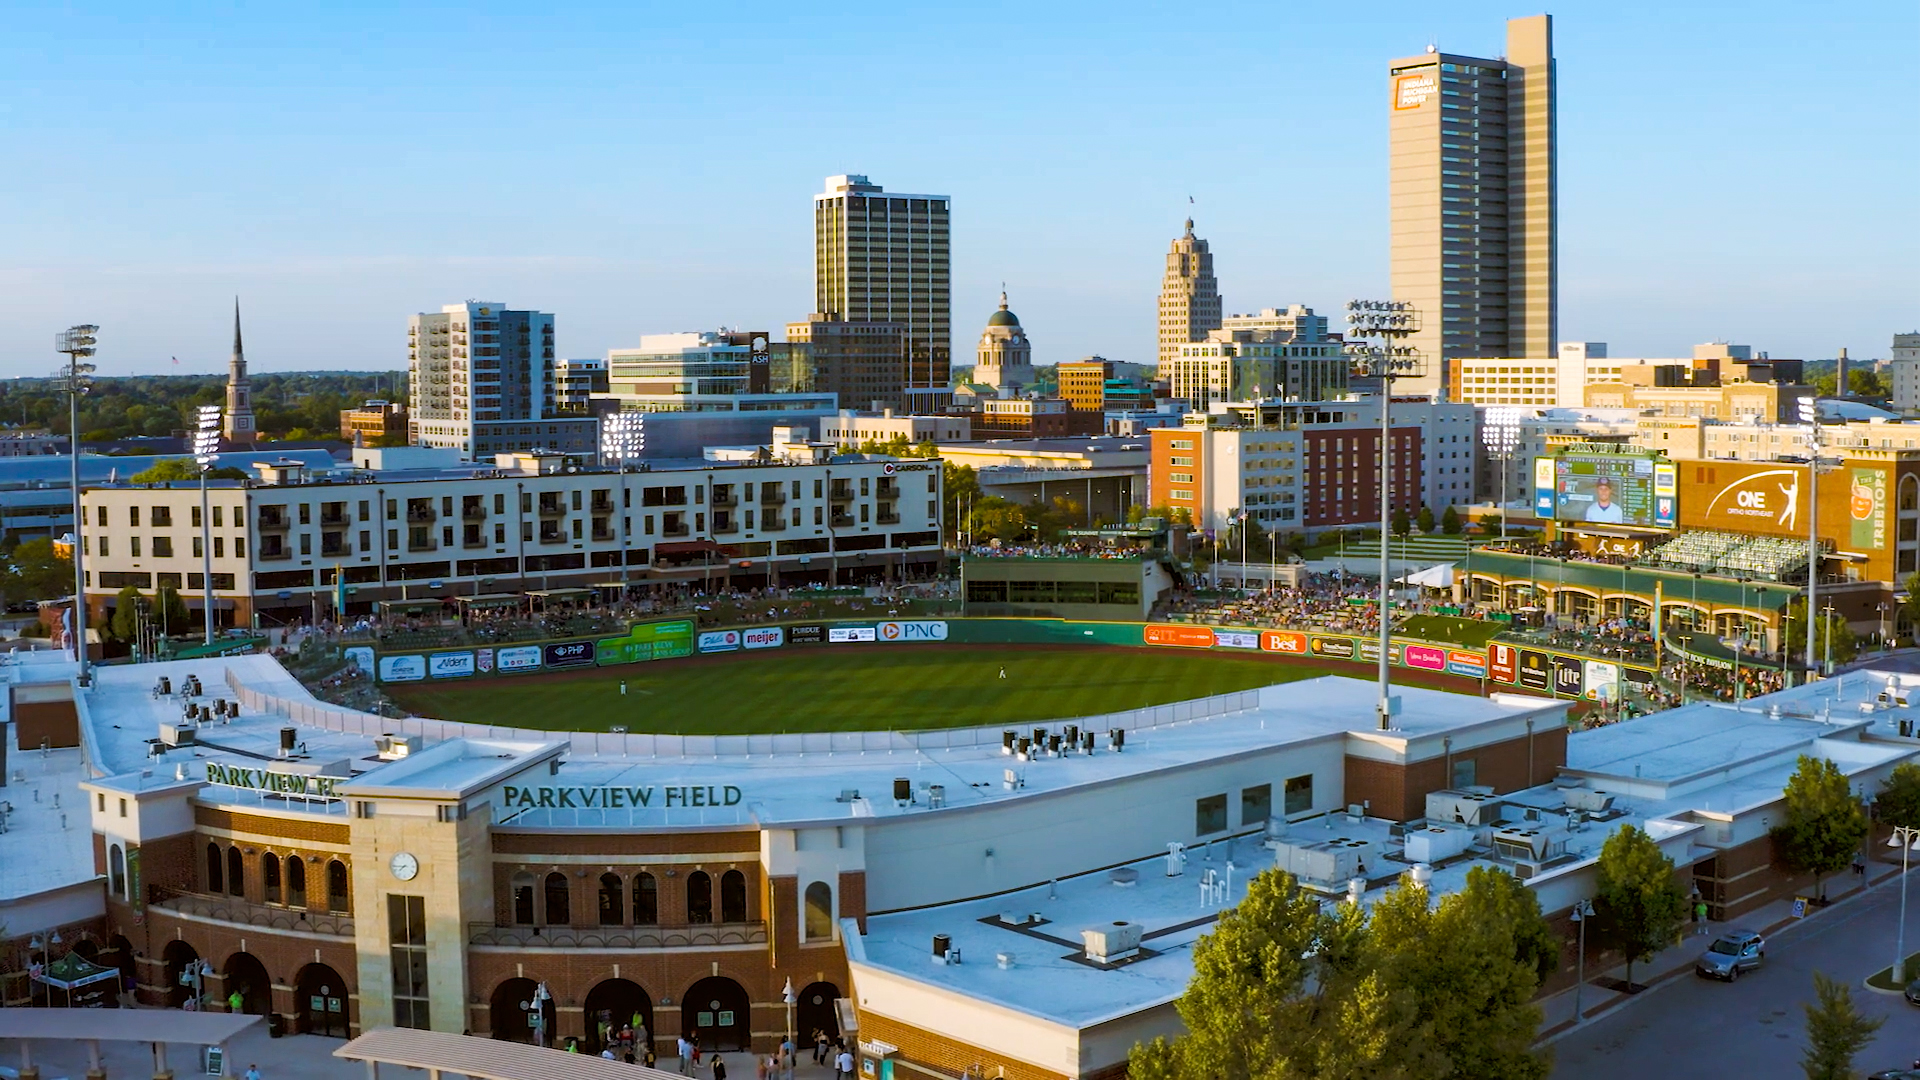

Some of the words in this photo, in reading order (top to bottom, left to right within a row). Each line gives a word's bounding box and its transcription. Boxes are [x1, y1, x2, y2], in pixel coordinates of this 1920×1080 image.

[752, 355, 769, 363] ASH
[895, 464, 928, 472] CARSON
[1859, 475, 1873, 484] THE
[1737, 490, 1766, 508] ONE
[1727, 507, 1745, 515] ORTHO
[1745, 509, 1774, 517] NORTHEAST
[1873, 470, 1886, 548] TREETOPS
[747, 630, 779, 644] meijer
[792, 627, 820, 635] PURDUE
[904, 624, 942, 638] PNC
[1270, 635, 1298, 650] Best
[567, 645, 585, 655] PHP
[1422, 653, 1441, 665] Bradley
[1706, 658, 1732, 670] PAVILION
[1557, 668, 1580, 687] Lite
[206, 762, 309, 794] PARKVIEW
[503, 786, 653, 808] PARKVIEW
[665, 786, 742, 806] FIELD
